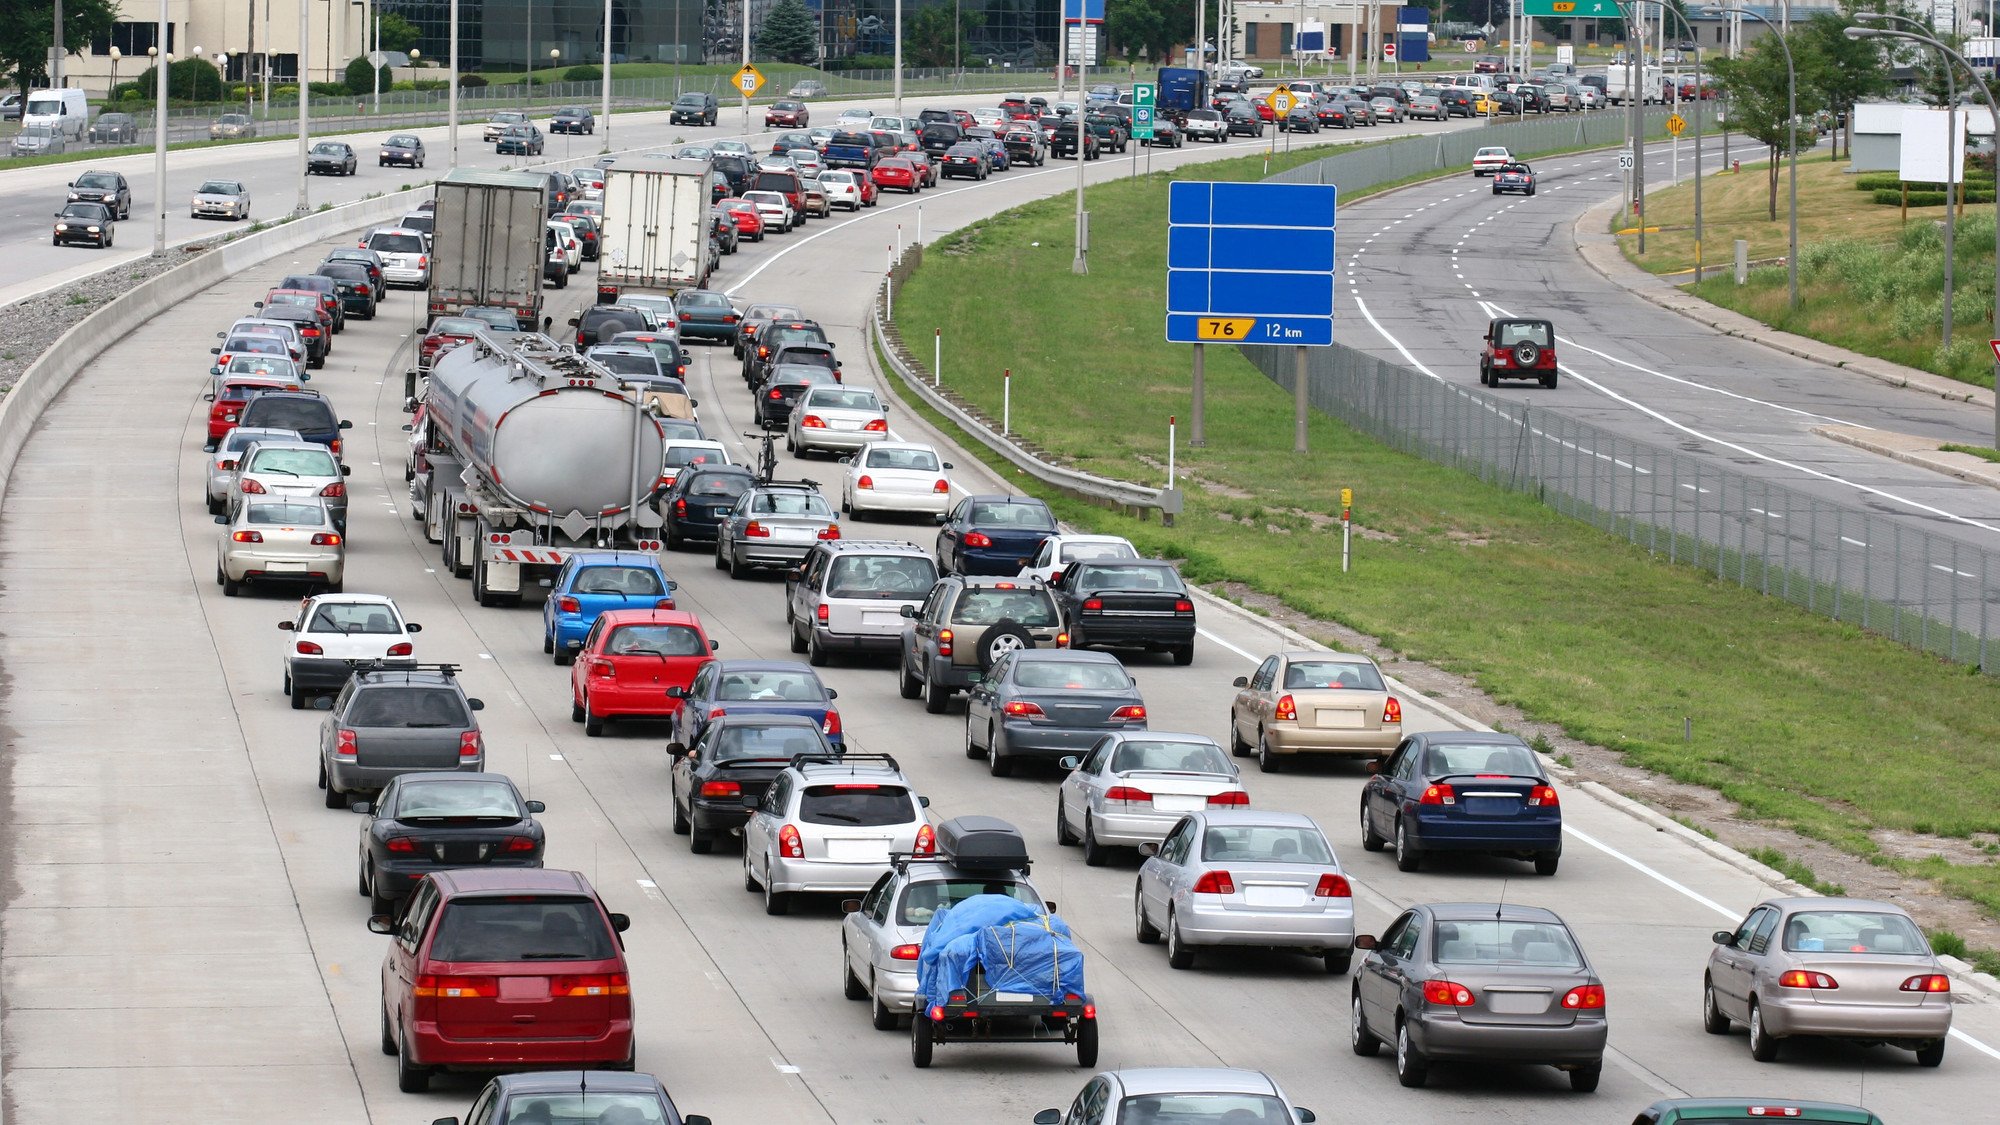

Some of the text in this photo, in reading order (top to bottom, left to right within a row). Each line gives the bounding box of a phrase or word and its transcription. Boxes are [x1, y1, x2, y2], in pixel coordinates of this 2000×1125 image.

[743, 79, 754, 88] 70
[1137, 86, 1150, 102] P
[1277, 99, 1287, 108] 70
[1620, 156, 1633, 168] 50
[1210, 322, 1302, 338] 76 12 km
